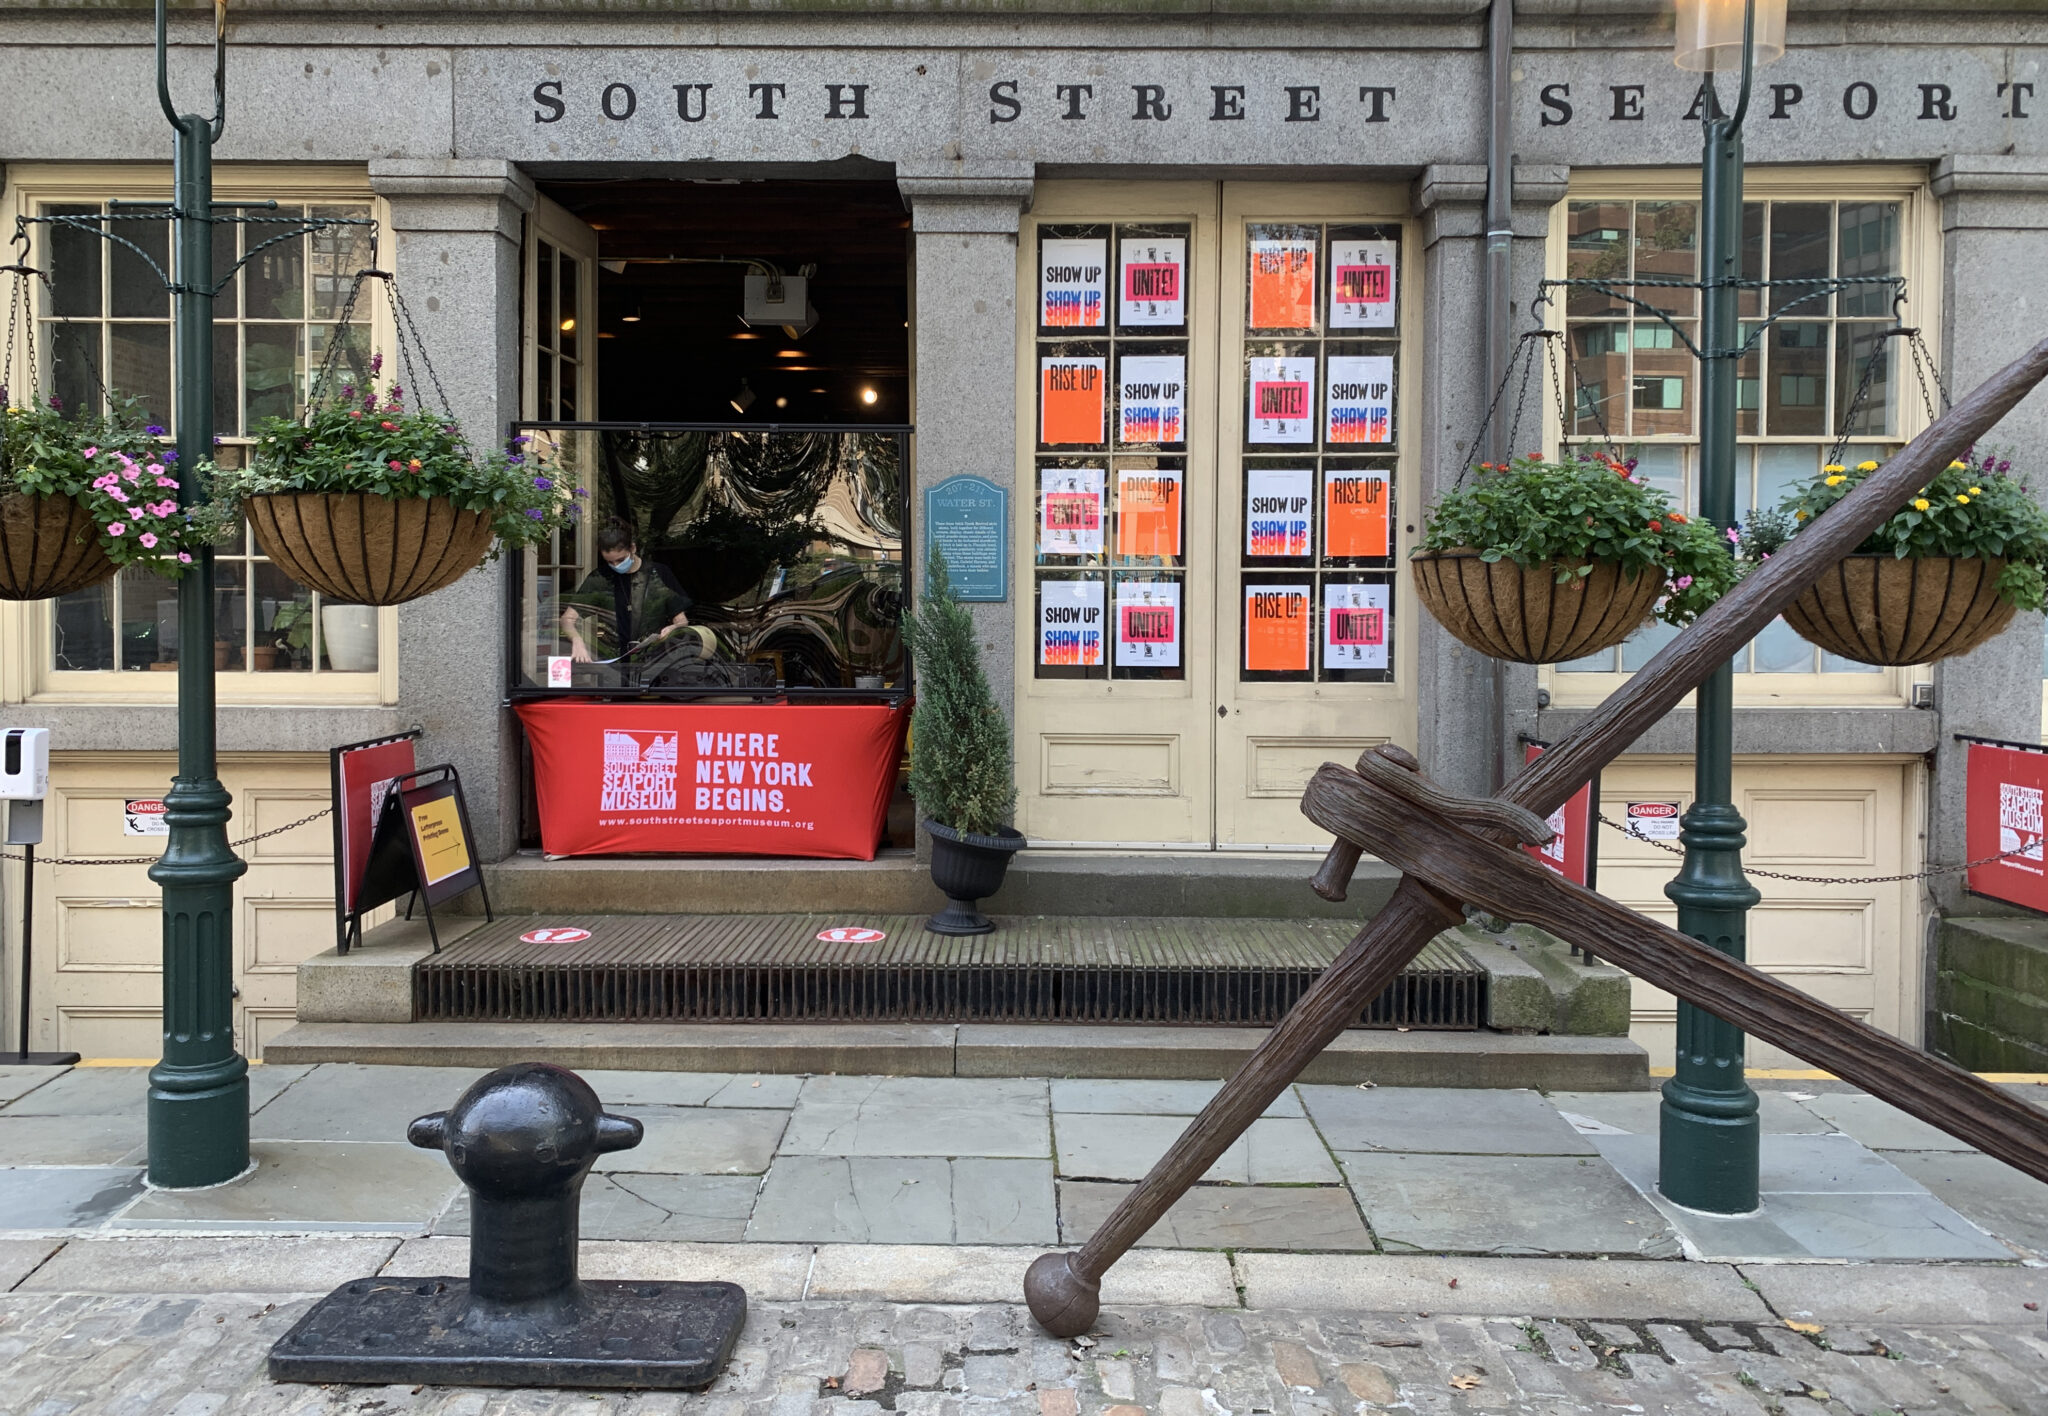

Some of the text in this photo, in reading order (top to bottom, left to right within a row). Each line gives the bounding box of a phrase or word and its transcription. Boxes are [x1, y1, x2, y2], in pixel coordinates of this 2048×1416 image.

[533, 79, 2035, 127] SOUTH STREET SEAPORT
[1291, 247, 1308, 274] UP
[1046, 266, 1101, 283] SHOW UP
[1133, 268, 1173, 296] UNITE!
[1343, 270, 1384, 298] UNITE!
[1045, 290, 1100, 306] SHOW UP
[1050, 364, 1097, 391] RISE UP
[1125, 383, 1180, 400] SHOW UP
[1261, 386, 1302, 414] UNITE!
[1332, 383, 1388, 400] SHOW UP
[1124, 407, 1179, 423] SHOW UP
[1331, 407, 1387, 424] SHOW UP
[1158, 476, 1174, 504] UP
[1334, 477, 1382, 504] RISE UP
[937, 499, 996, 507] WATER ST.
[1252, 497, 1307, 513] SHOW UP
[1251, 520, 1306, 536] SHOW UP
[1045, 607, 1100, 623] SHOW UP
[1254, 592, 1302, 618] RISE UP
[1129, 611, 1169, 638] UNITE!
[1336, 613, 1378, 640] UNITE!
[1044, 630, 1099, 646] SHOW UP
[695, 731, 779, 757] WHERE
[603, 762, 677, 775] SOUTH STREET
[695, 760, 814, 787] NEW YORK
[602, 773, 677, 792] SEAPORT
[601, 790, 677, 811] MUSEUM
[695, 787, 791, 813] BEGINS.
[1633, 806, 1672, 815] DANGER
[2000, 793, 2043, 816] SEAPORT
[599, 816, 815, 830] www.southstreetseaportmuseum.org
[2001, 809, 2043, 833] MUSEUM
